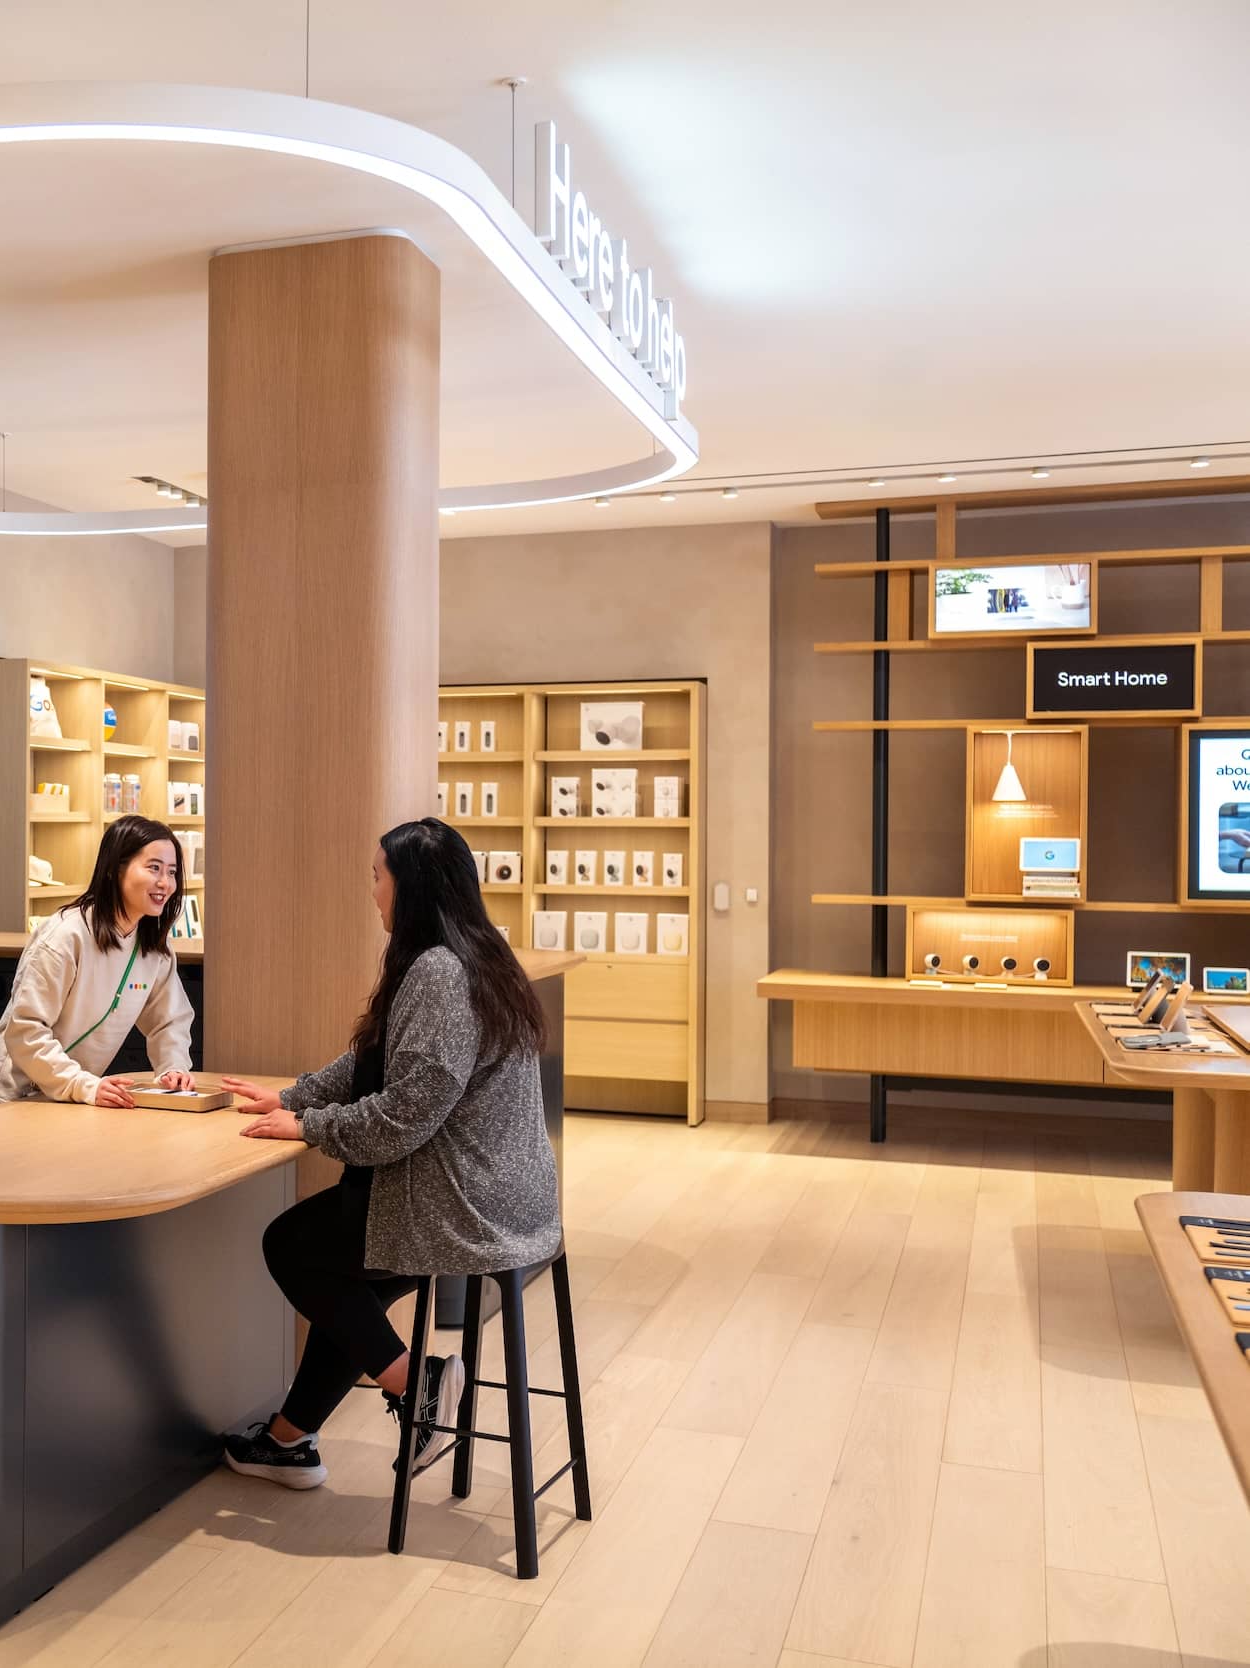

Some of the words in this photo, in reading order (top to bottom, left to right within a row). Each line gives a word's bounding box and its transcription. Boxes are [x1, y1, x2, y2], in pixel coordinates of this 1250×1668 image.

[548, 119, 614, 313] Here
[619, 235, 644, 349] to
[647, 265, 687, 420] help
[1057, 671, 1111, 687] Smart
[1114, 670, 1168, 686] Home
